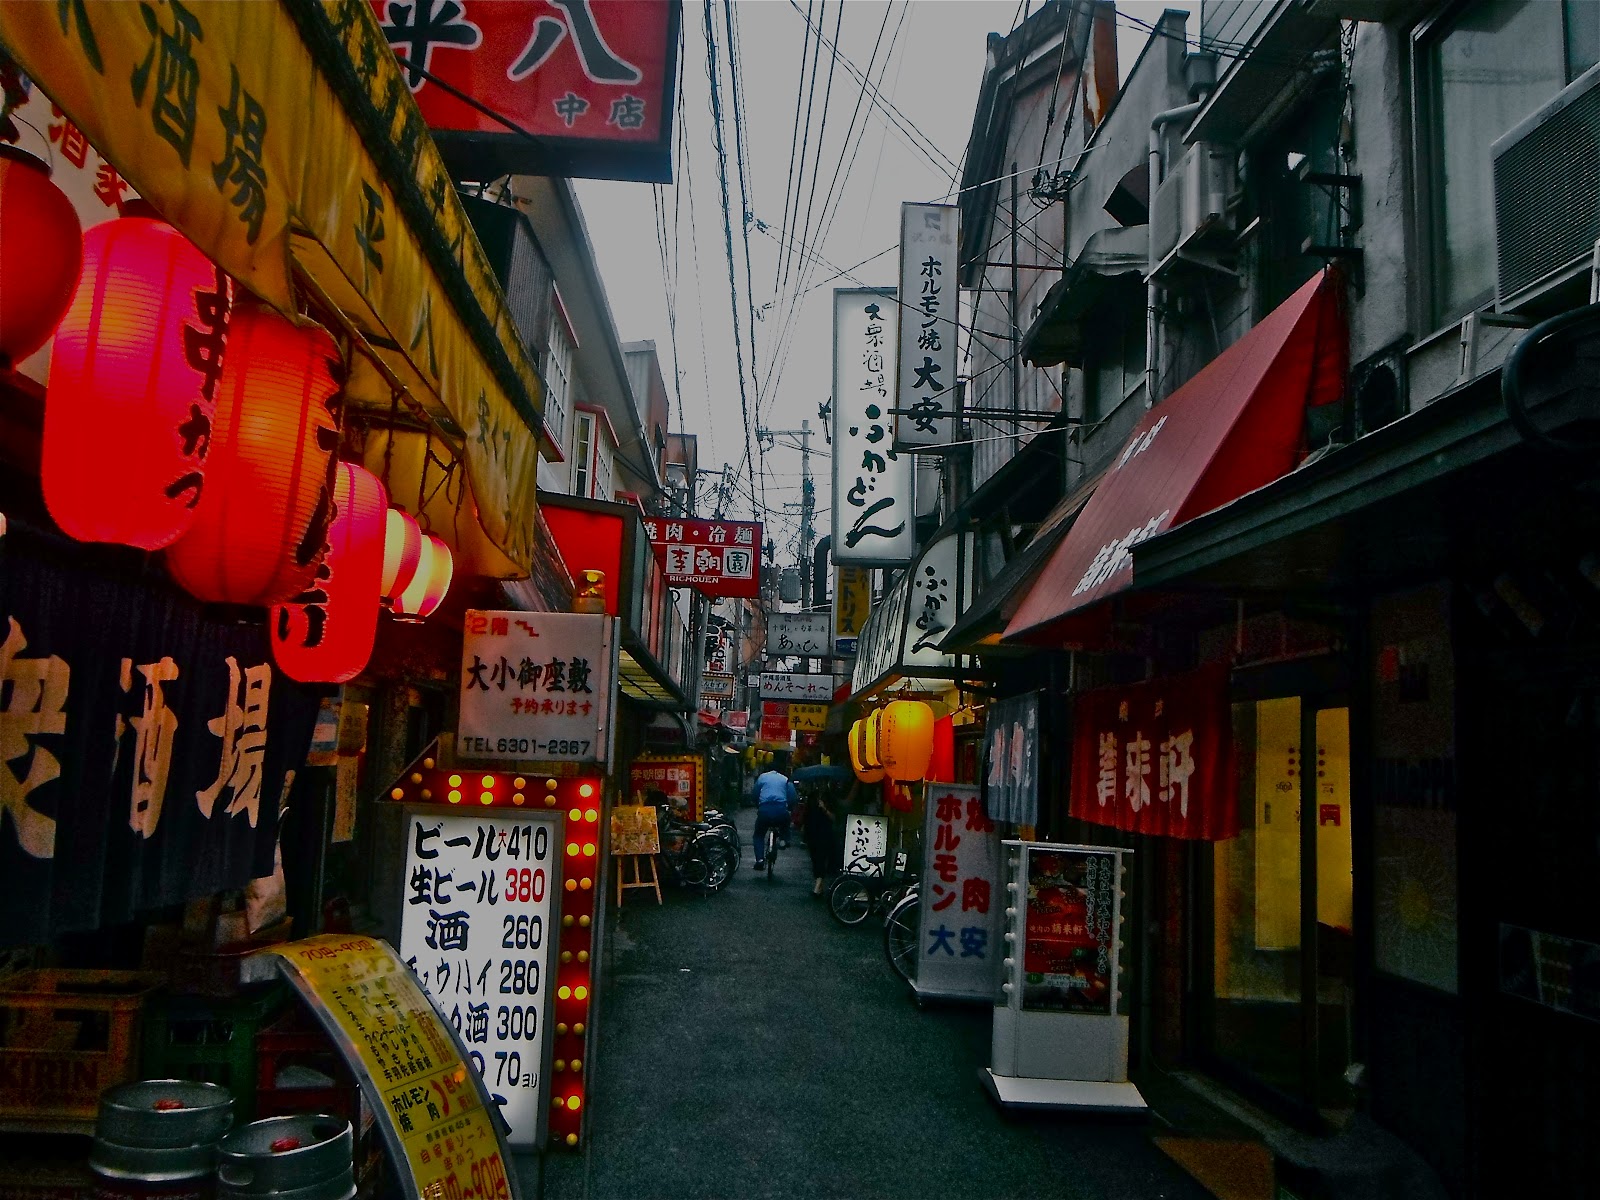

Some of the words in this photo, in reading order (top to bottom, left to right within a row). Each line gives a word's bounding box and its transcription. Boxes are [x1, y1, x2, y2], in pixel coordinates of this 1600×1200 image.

[380, 0, 643, 93] 平八
[57, 0, 268, 245] 酒場
[553, 92, 646, 130] 中店
[916, 255, 943, 353] ホルモン焼
[911, 357, 945, 436] 大安
[669, 575, 719, 583] RICHOUEN
[471, 617, 509, 636] 2階
[466, 655, 593, 694] 大小御座敷
[510, 697, 593, 716] 予約承ります
[464, 736, 494, 752] TEL
[415, 821, 499, 861] ビール
[506, 825, 548, 861] 410
[932, 793, 962, 912] ホルモン
[409, 864, 499, 906] 生ビール
[505, 867, 546, 903] 380
[425, 909, 470, 951] 酒
[502, 914, 542, 950] 260
[928, 924, 988, 959] 大安
[499, 959, 540, 995] 280
[496, 1005, 538, 1041] 300
[391, 1086, 430, 1113] ホルモン
